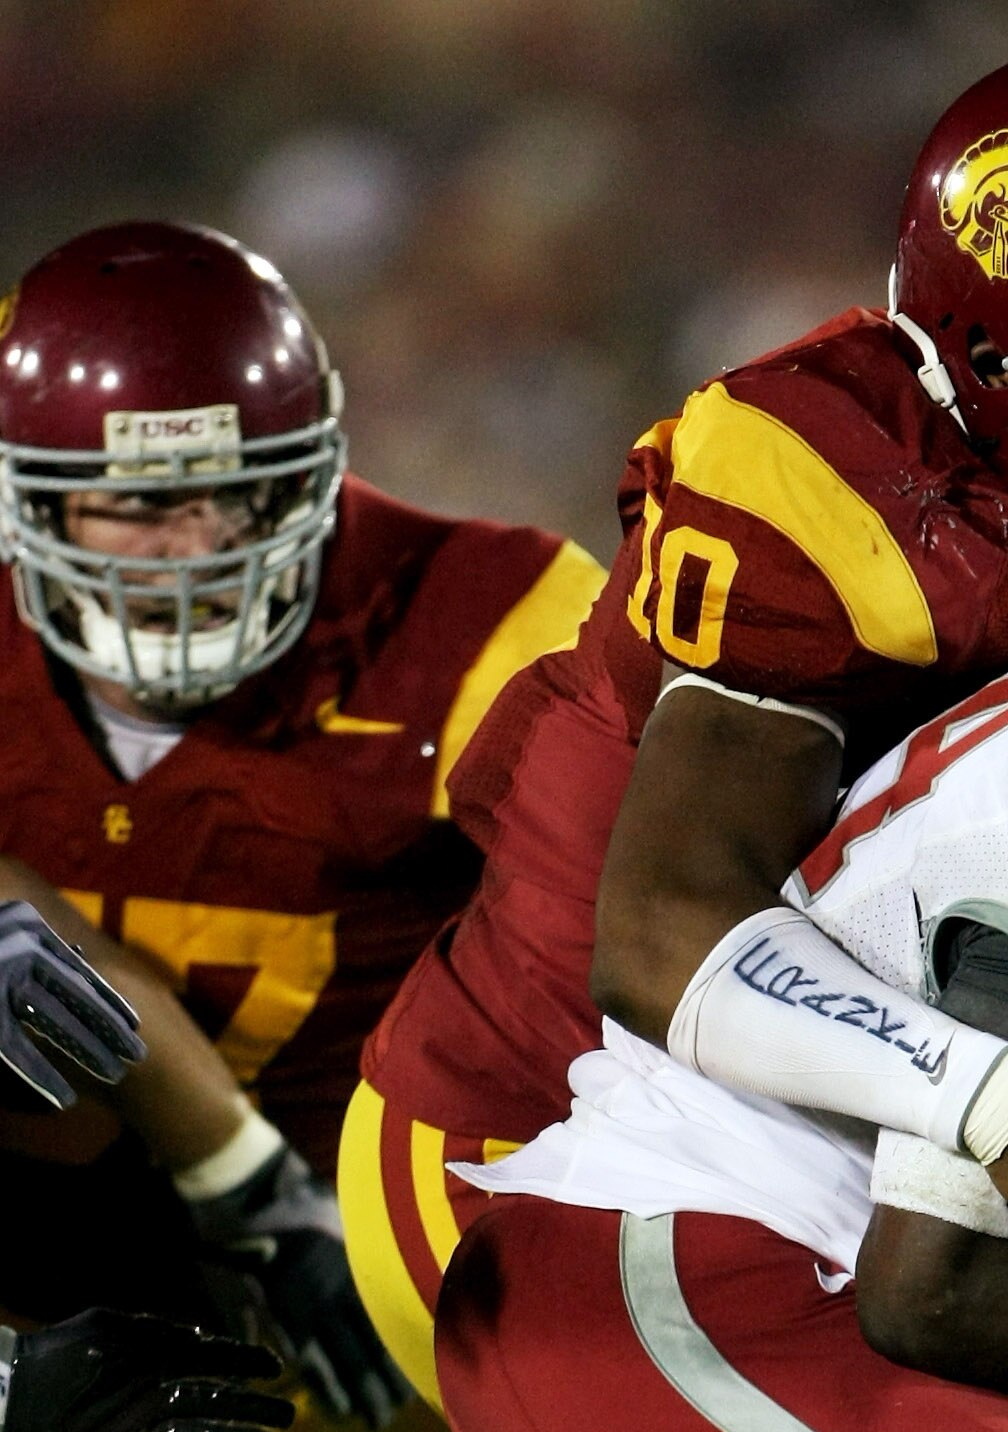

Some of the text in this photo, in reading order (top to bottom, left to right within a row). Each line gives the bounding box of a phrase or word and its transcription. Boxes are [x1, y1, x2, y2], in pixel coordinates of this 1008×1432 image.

[141, 418, 203, 438] USC
[626, 491, 740, 669] 10
[733, 936, 947, 1074] FRANKIE
